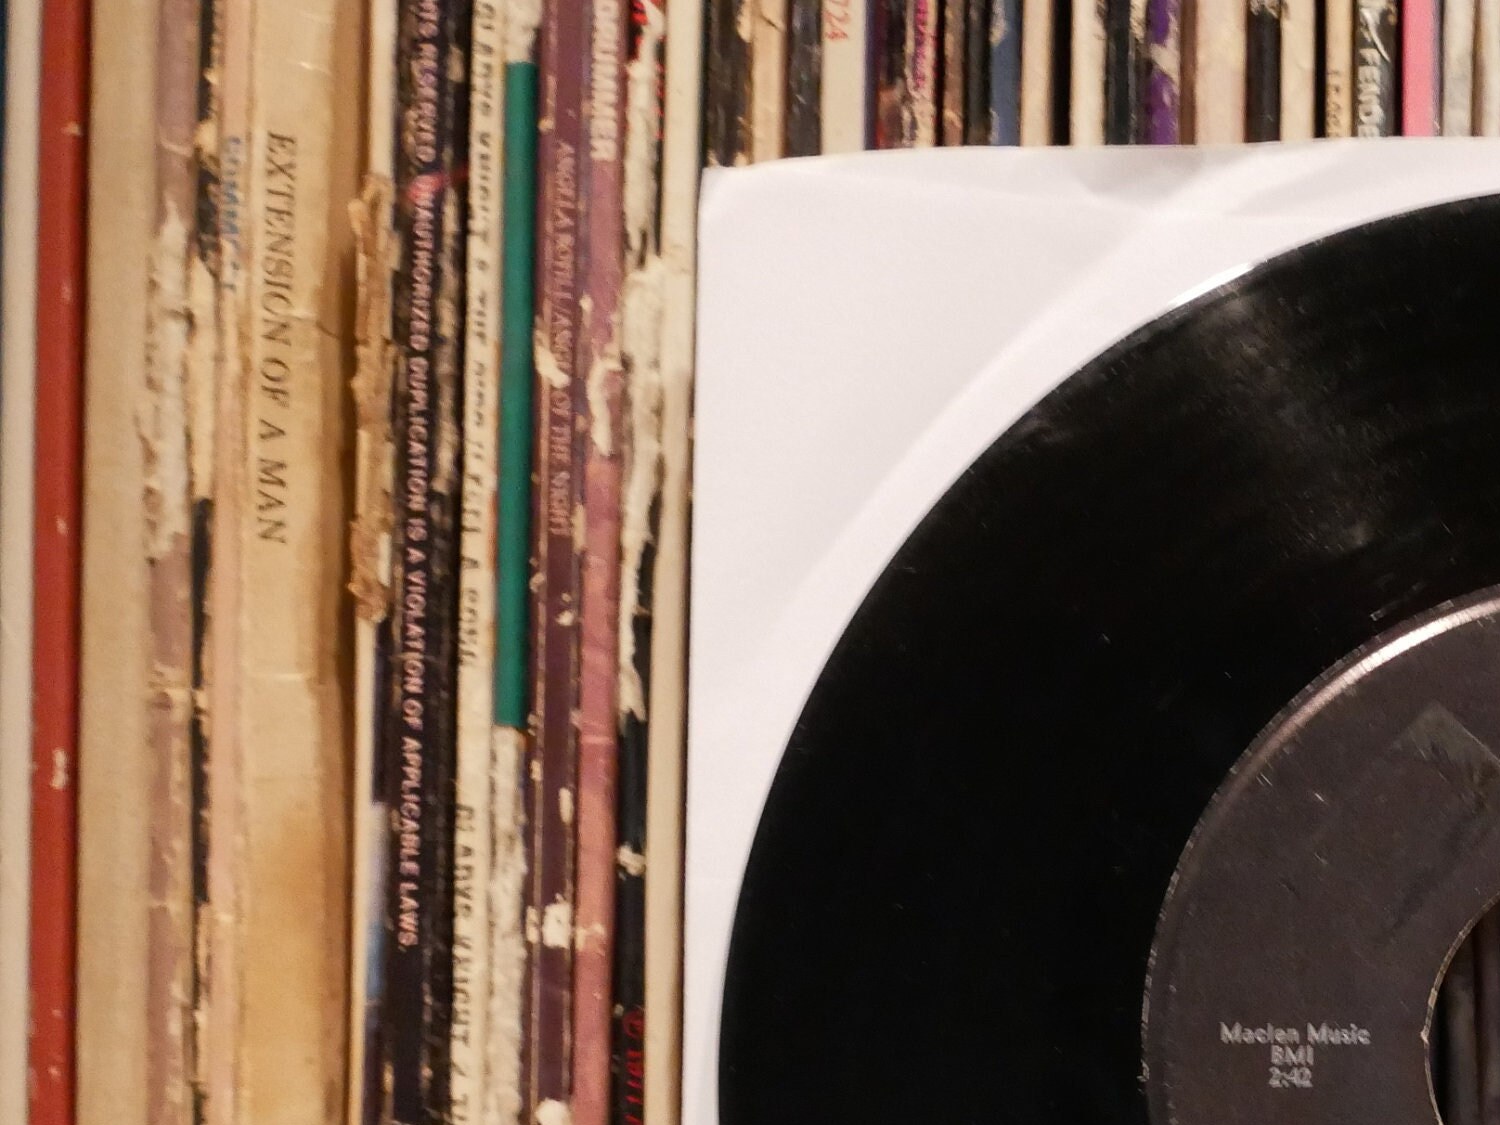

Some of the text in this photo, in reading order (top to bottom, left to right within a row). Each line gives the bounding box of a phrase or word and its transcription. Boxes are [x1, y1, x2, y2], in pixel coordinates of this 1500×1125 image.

[255, 130, 297, 545] EXTENSION OF A MAN
[406, 517, 429, 542] IS
[402, 568, 429, 695] VIOLATION
[401, 699, 425, 730] OF
[398, 735, 424, 874] APPLICABLE
[1306, 1022, 1372, 1045] Music
[1270, 1044, 1315, 1067] BMI
[1268, 1066, 1314, 1089] 2:42
